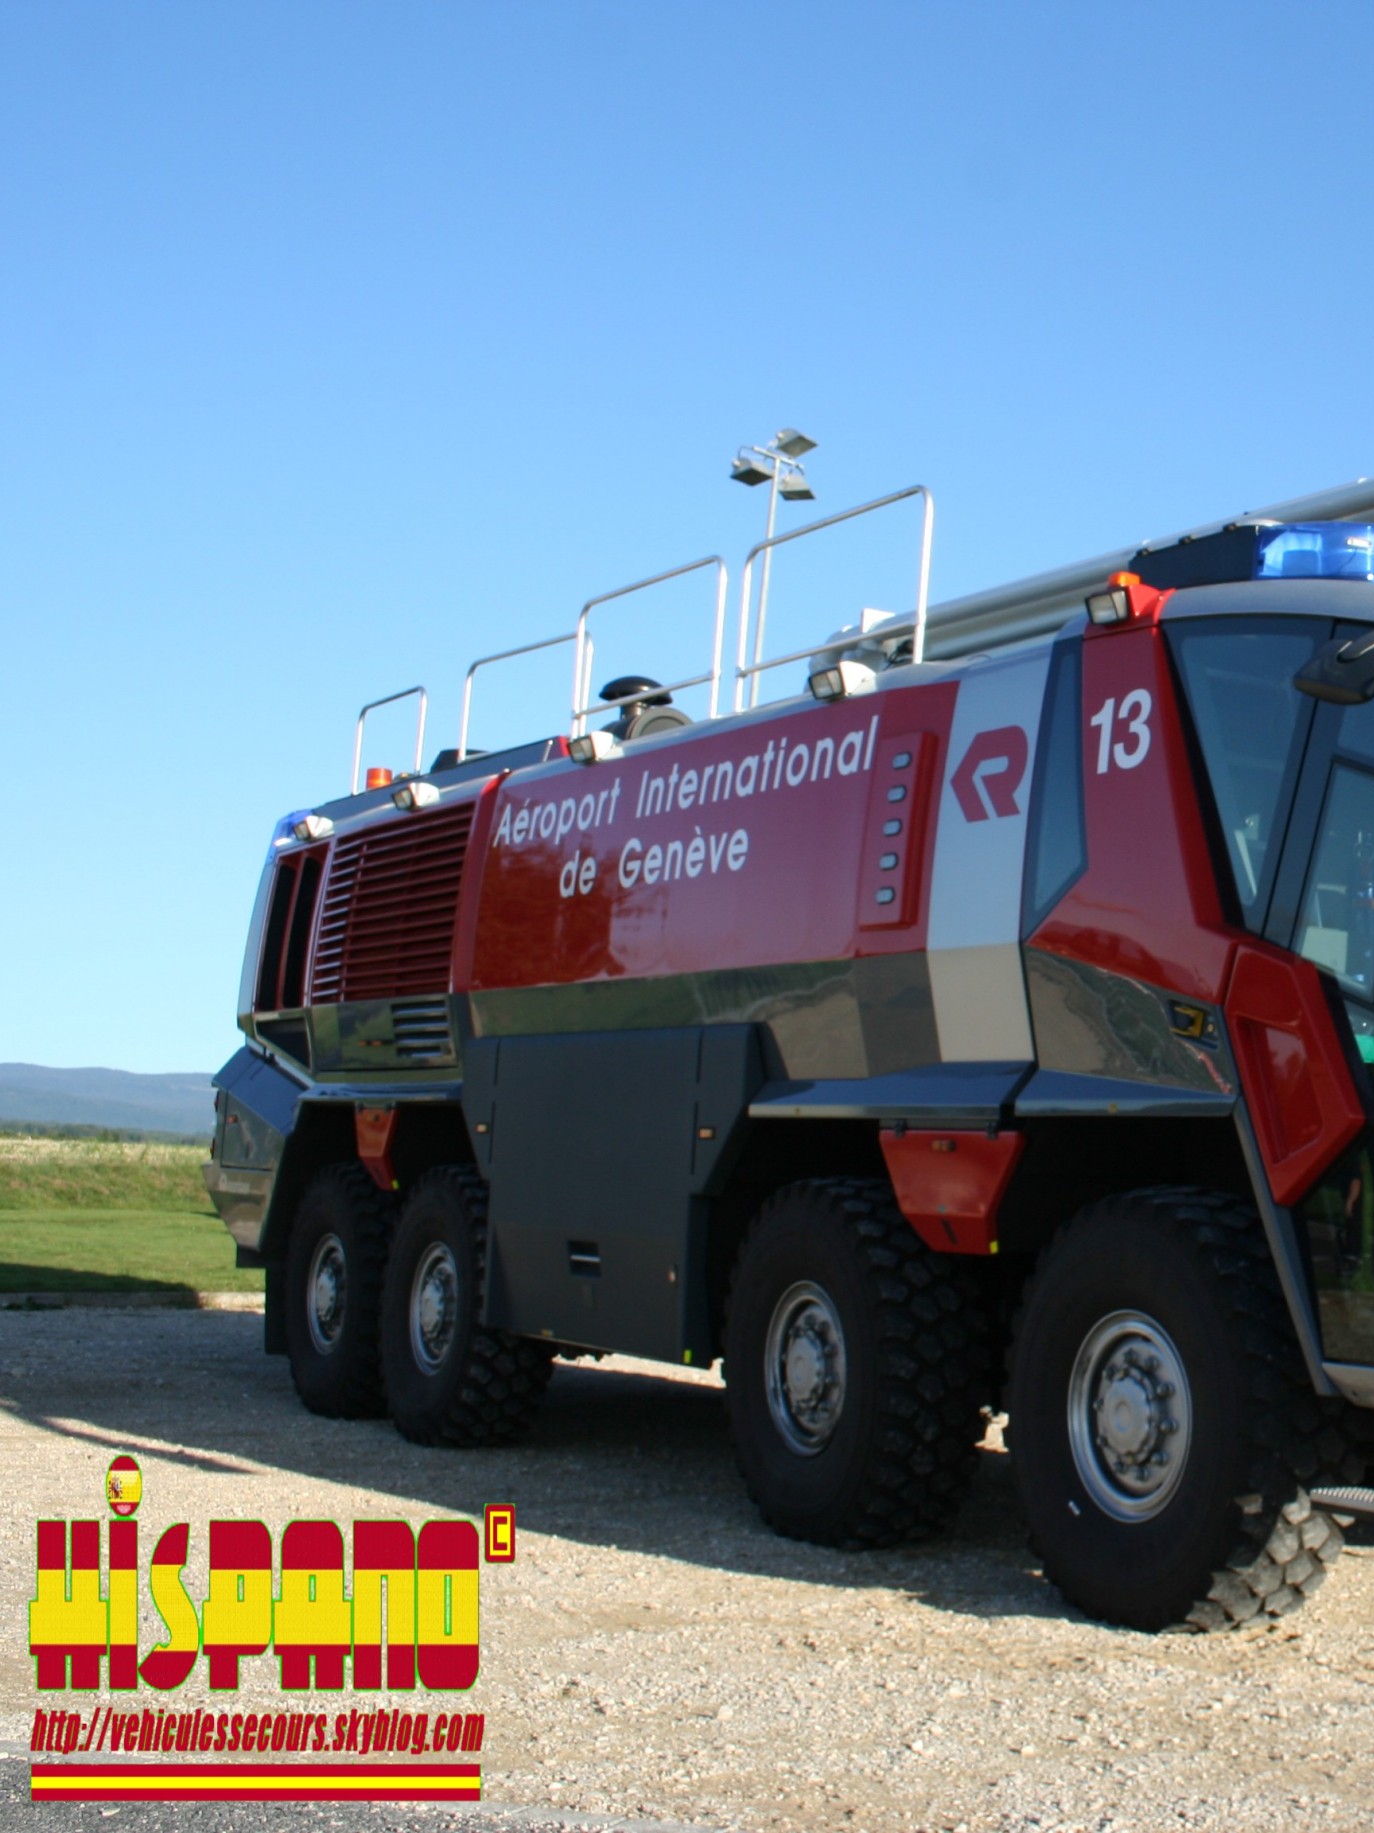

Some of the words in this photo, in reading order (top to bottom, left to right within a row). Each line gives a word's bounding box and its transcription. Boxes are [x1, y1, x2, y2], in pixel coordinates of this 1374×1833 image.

[1090, 688, 1152, 774] 13
[493, 777, 621, 847] Aéroport
[635, 714, 880, 818] International
[559, 850, 597, 897] de
[618, 827, 749, 888] Genève
